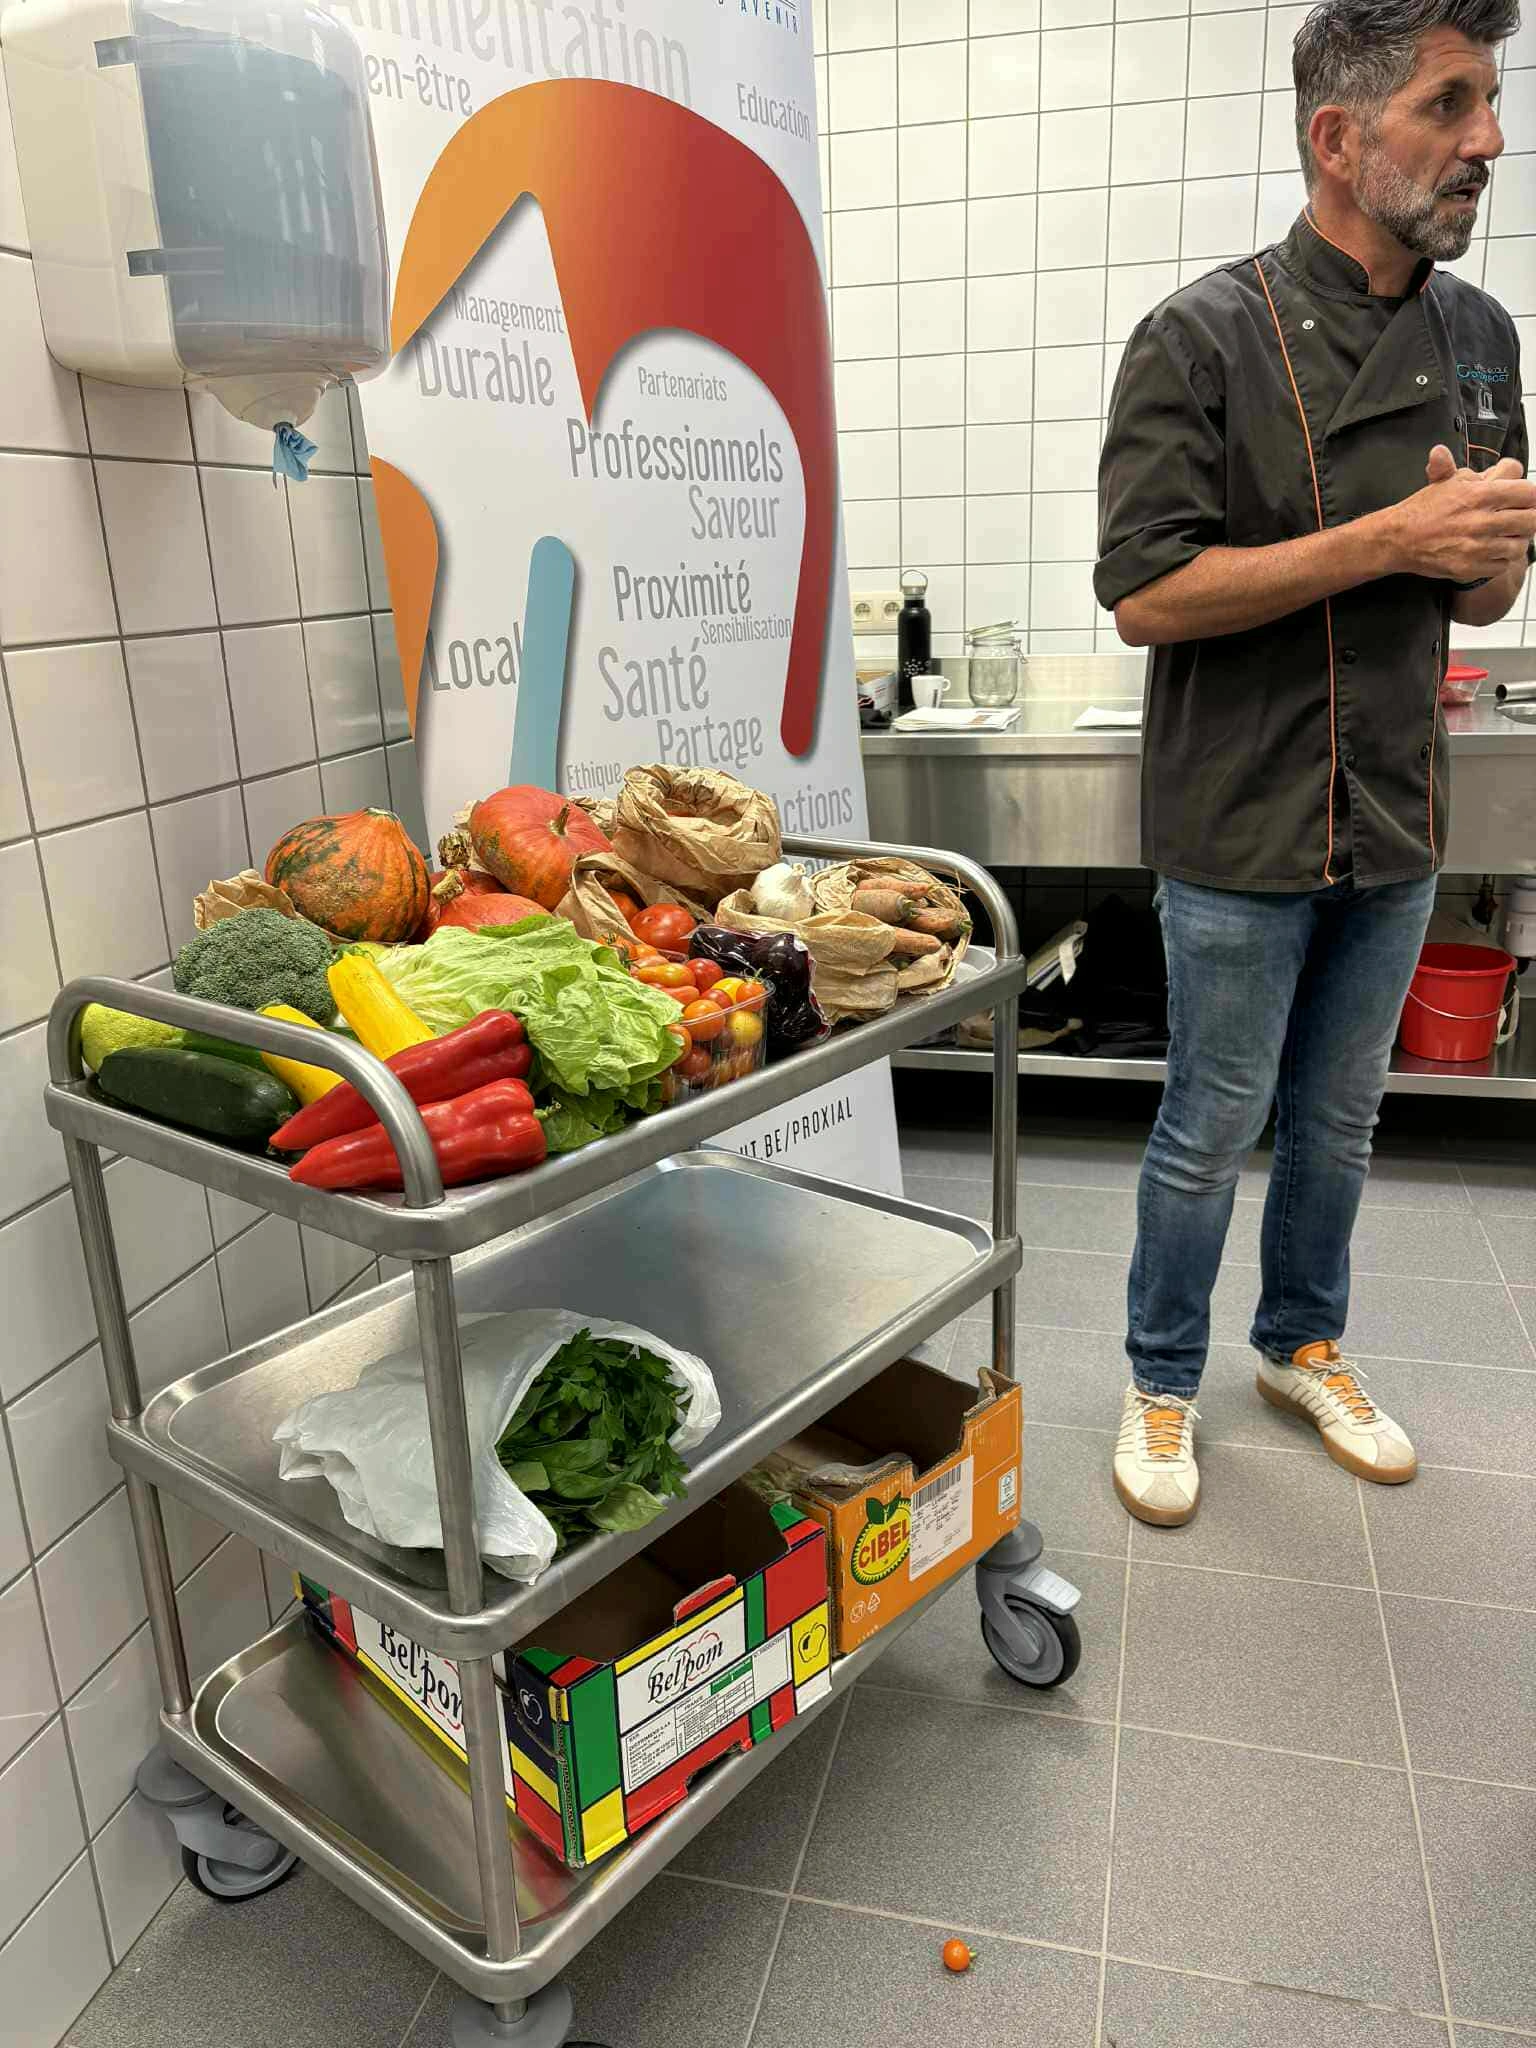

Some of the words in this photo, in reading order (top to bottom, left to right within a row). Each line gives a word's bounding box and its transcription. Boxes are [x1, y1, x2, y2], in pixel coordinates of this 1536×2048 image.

[741, 0, 798, 34] AVENIR
[328, 0, 692, 107] mentation
[736, 82, 811, 143] Education
[451, 288, 565, 333] Management
[415, 330, 555, 406] Durable
[638, 366, 728, 401] Partenariats
[567, 418, 783, 482] Professionnels
[689, 485, 780, 540] Saveur
[613, 559, 752, 622] Proximité
[426, 621, 523, 691] Local
[700, 614, 792, 646] Sensibilisation
[598, 636, 710, 722] Santé
[657, 716, 763, 769] Partage
[566, 761, 622, 792] Ethique
[858, 1518, 910, 1569] CIBEL
